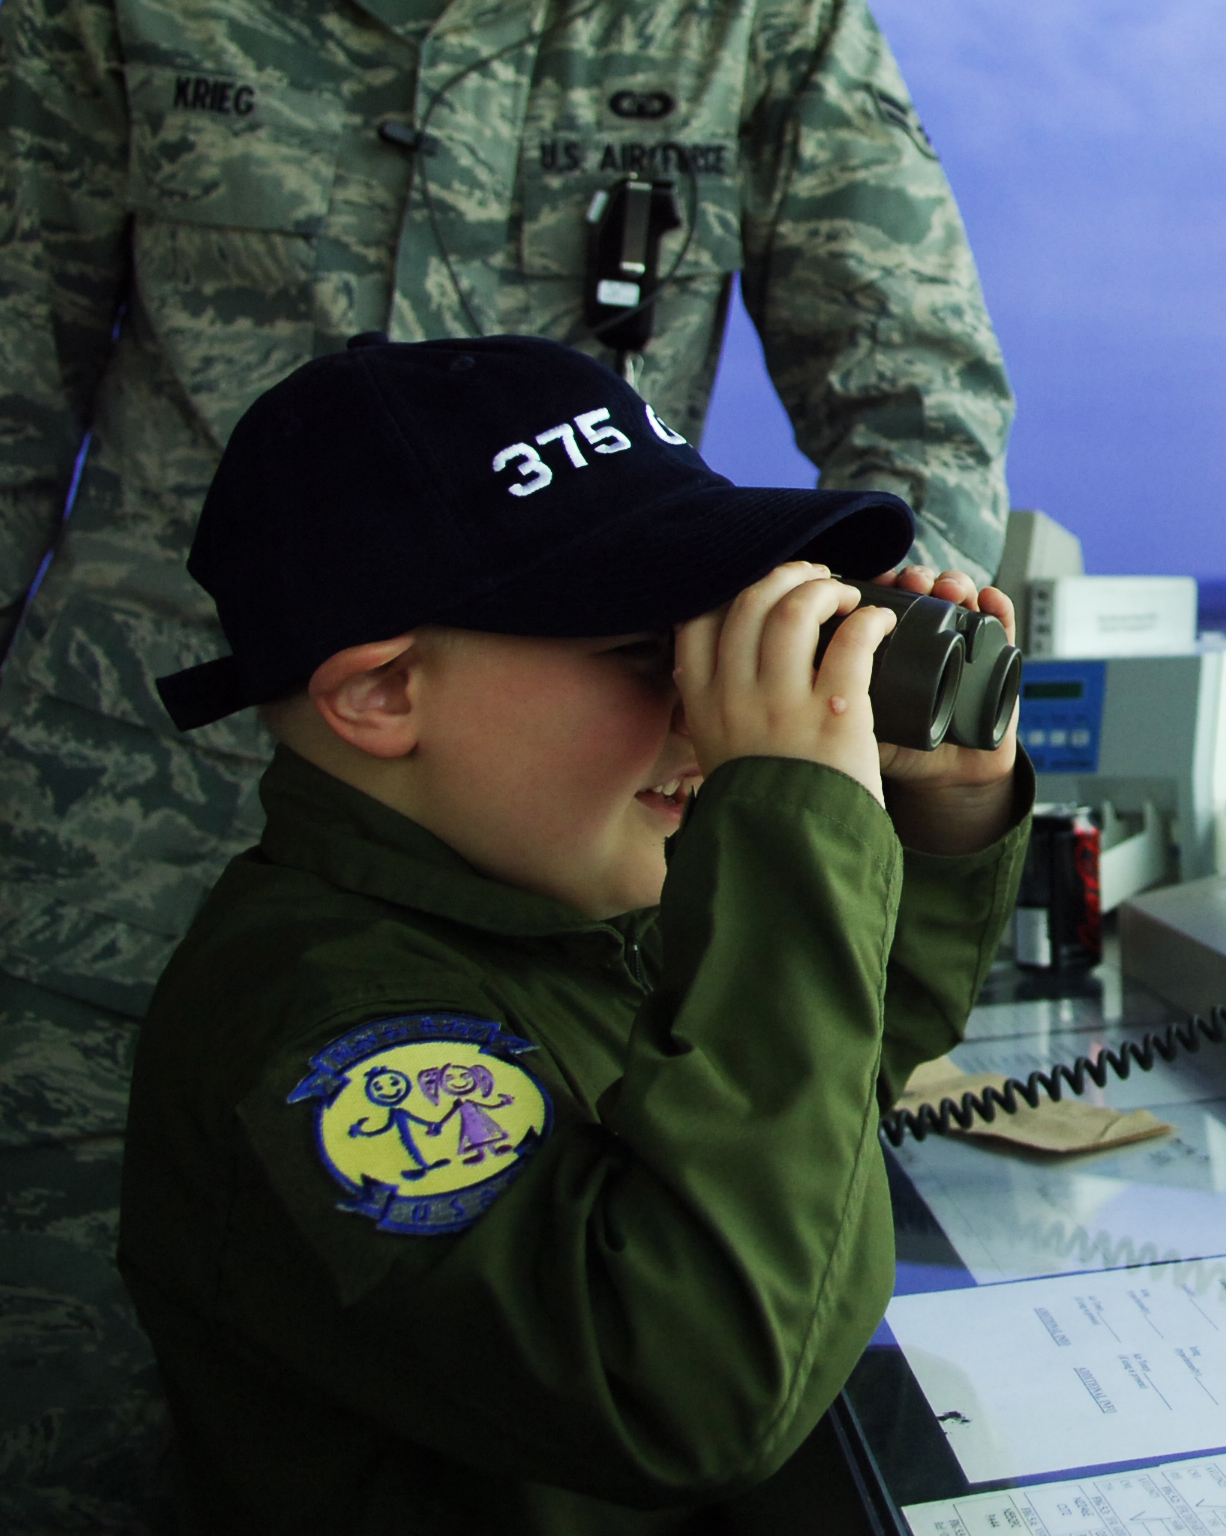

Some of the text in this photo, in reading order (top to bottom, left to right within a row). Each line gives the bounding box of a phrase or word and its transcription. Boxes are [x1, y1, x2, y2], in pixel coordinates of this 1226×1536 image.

[174, 75, 256, 116] KRIEG
[600, 142, 644, 172] AIR
[492, 406, 632, 498] 375
[1076, 1366, 1118, 1414] ADDITIONAL INFO
